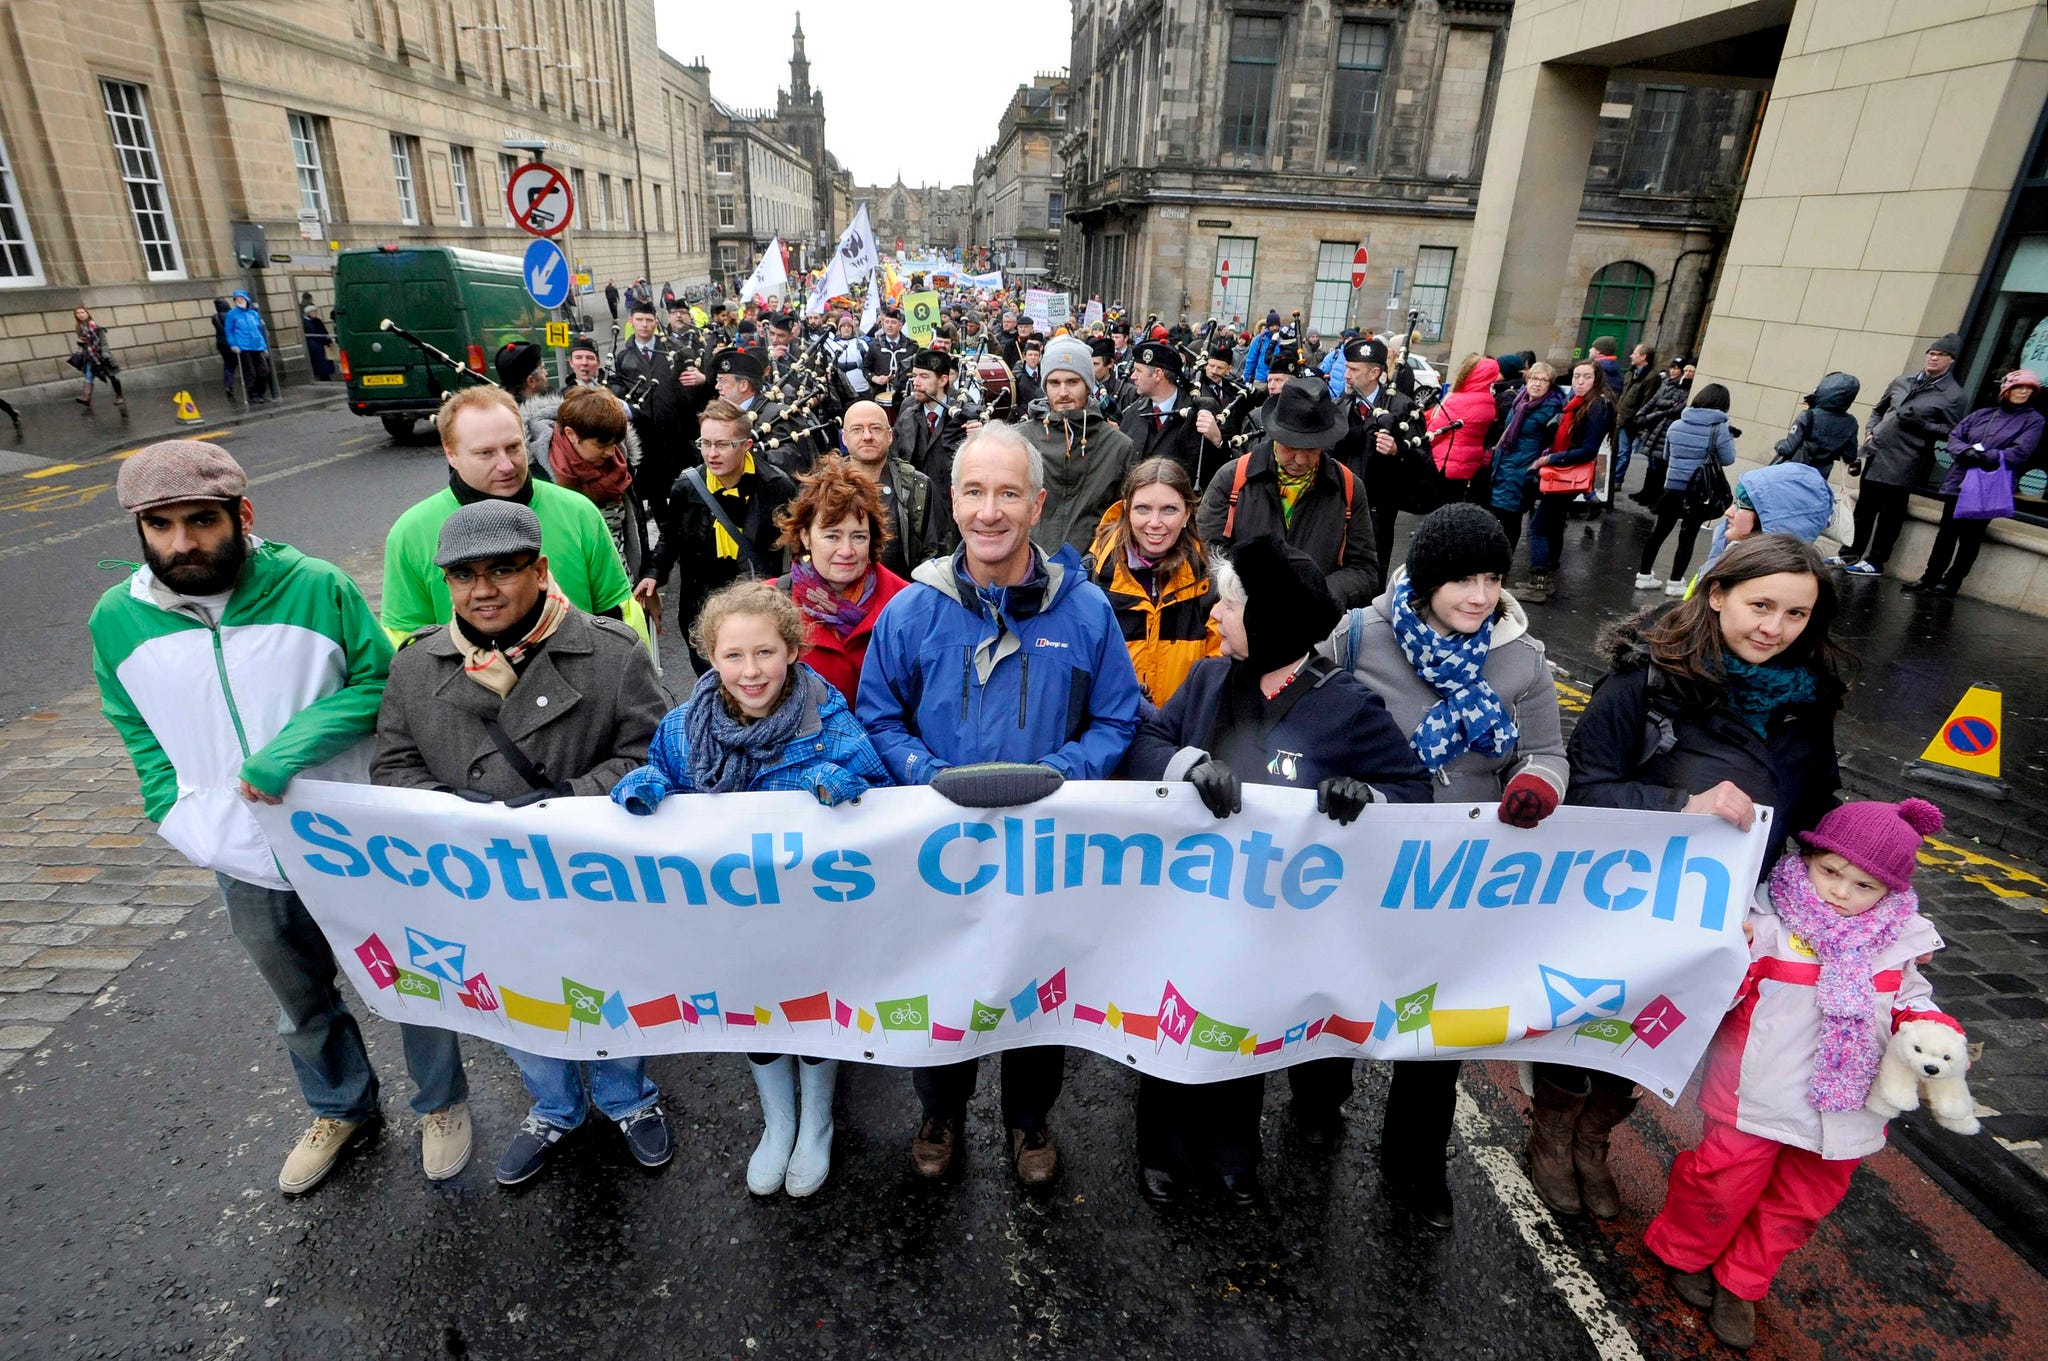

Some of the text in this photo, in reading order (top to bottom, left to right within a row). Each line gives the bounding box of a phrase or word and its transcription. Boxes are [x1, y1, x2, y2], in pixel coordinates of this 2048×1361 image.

[550, 325, 565, 343] H
[912, 324, 931, 334] OXFA
[290, 810, 1731, 931] Scotland's Climate March
